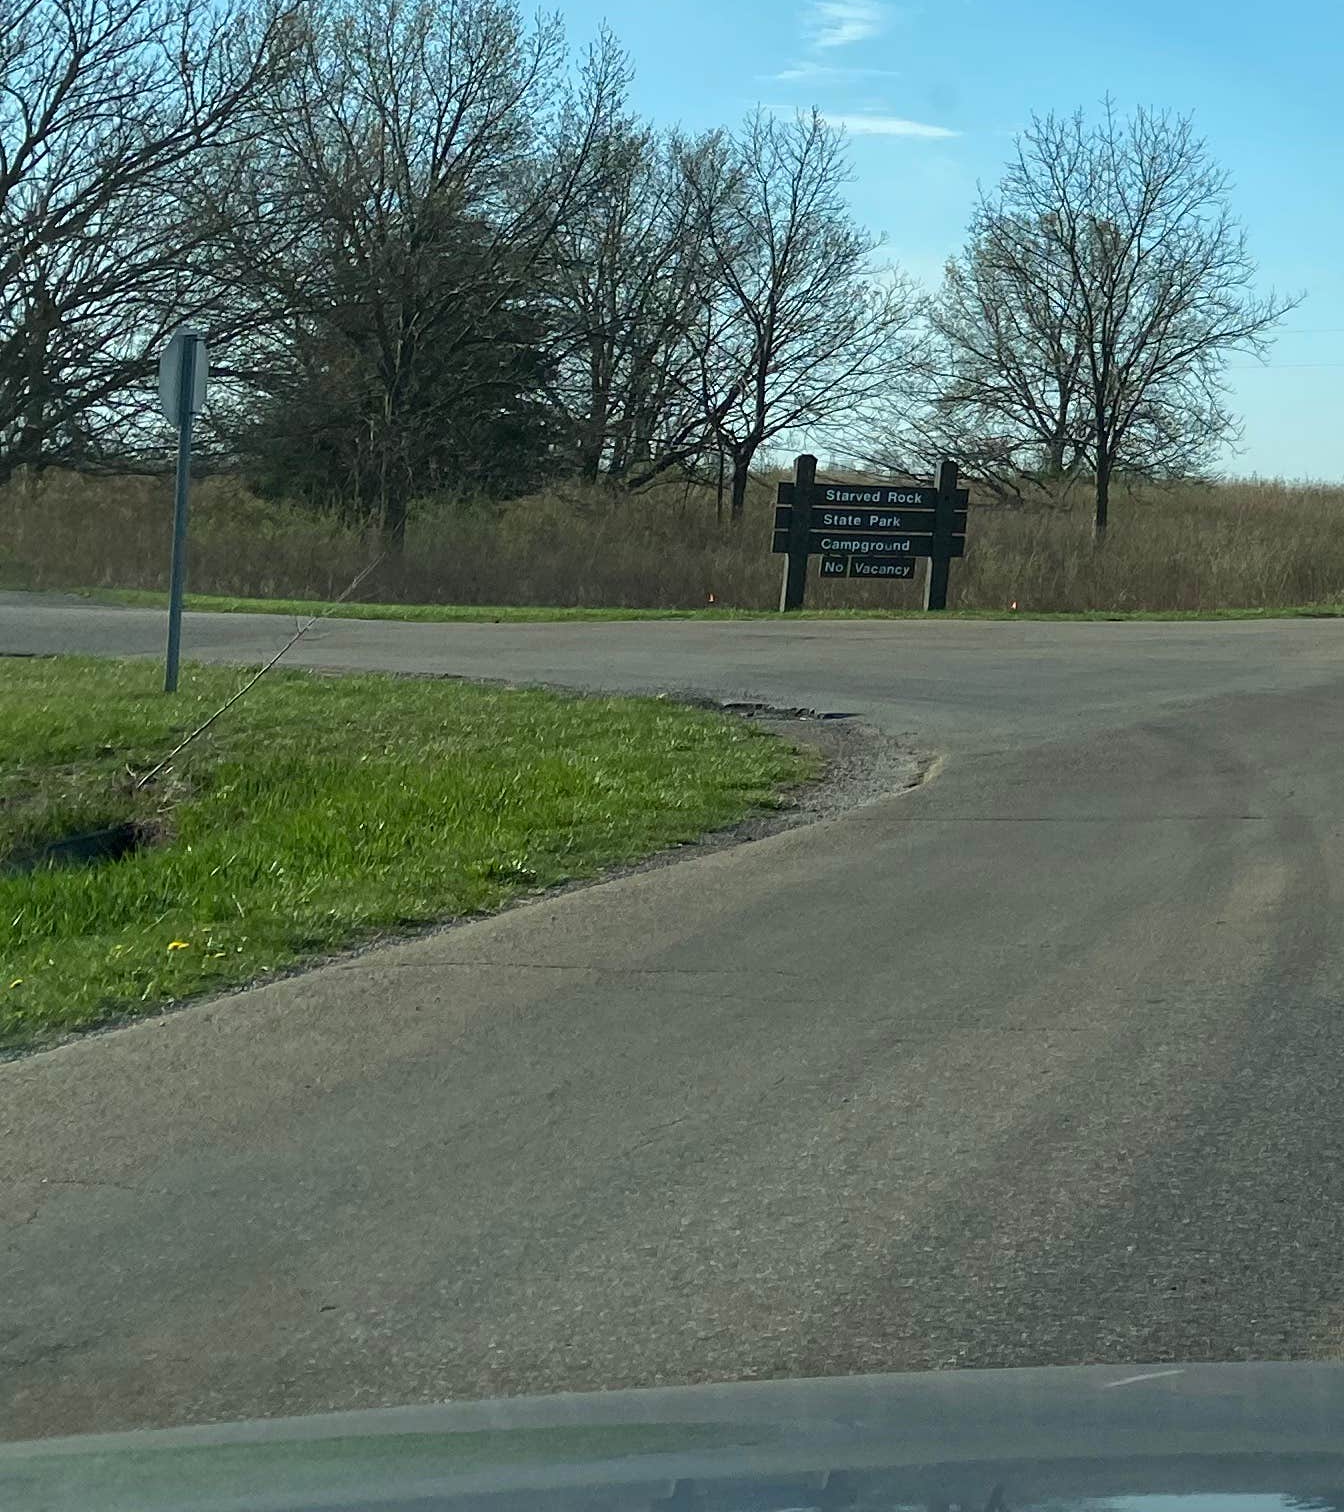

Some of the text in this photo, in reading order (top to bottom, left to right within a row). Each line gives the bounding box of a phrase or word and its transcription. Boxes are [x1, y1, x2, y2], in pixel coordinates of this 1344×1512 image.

[826, 490, 922, 503] Starved Rock
[823, 514, 901, 527] State Park
[821, 539, 910, 552] Campground
[824, 562, 910, 576] No Vacancy
